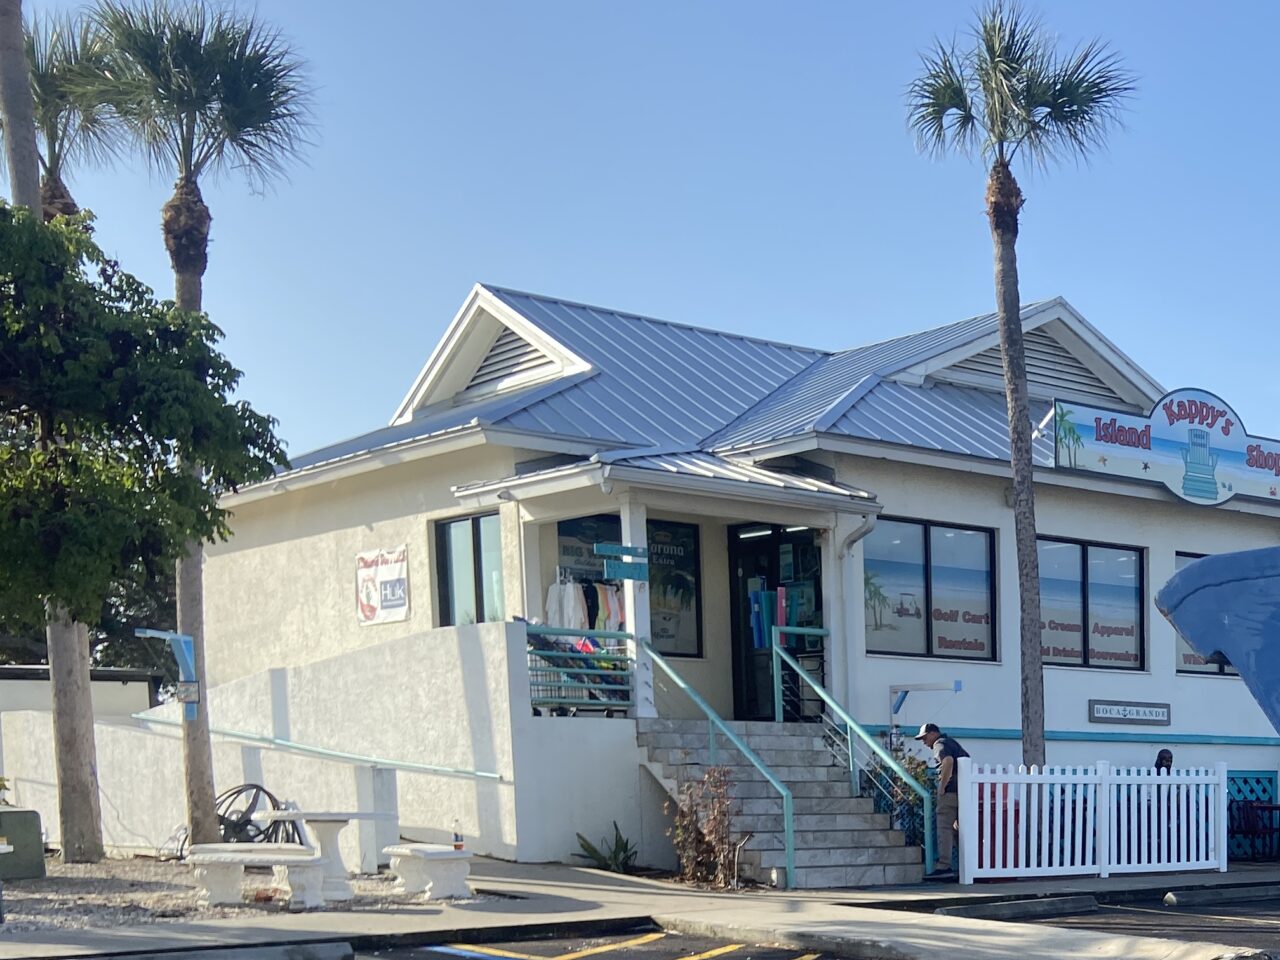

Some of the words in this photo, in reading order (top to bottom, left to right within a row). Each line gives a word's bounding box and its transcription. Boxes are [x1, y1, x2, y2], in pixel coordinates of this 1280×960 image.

[1162, 399, 1234, 436] Kappy's
[1094, 417, 1151, 450] Island
[650, 543, 684, 556] orona
[932, 608, 959, 622] Golf
[961, 610, 990, 625] Cart
[937, 636, 985, 651] Rentals
[1095, 706, 1121, 716] BOCA
[1128, 708, 1167, 718] GRANDE
